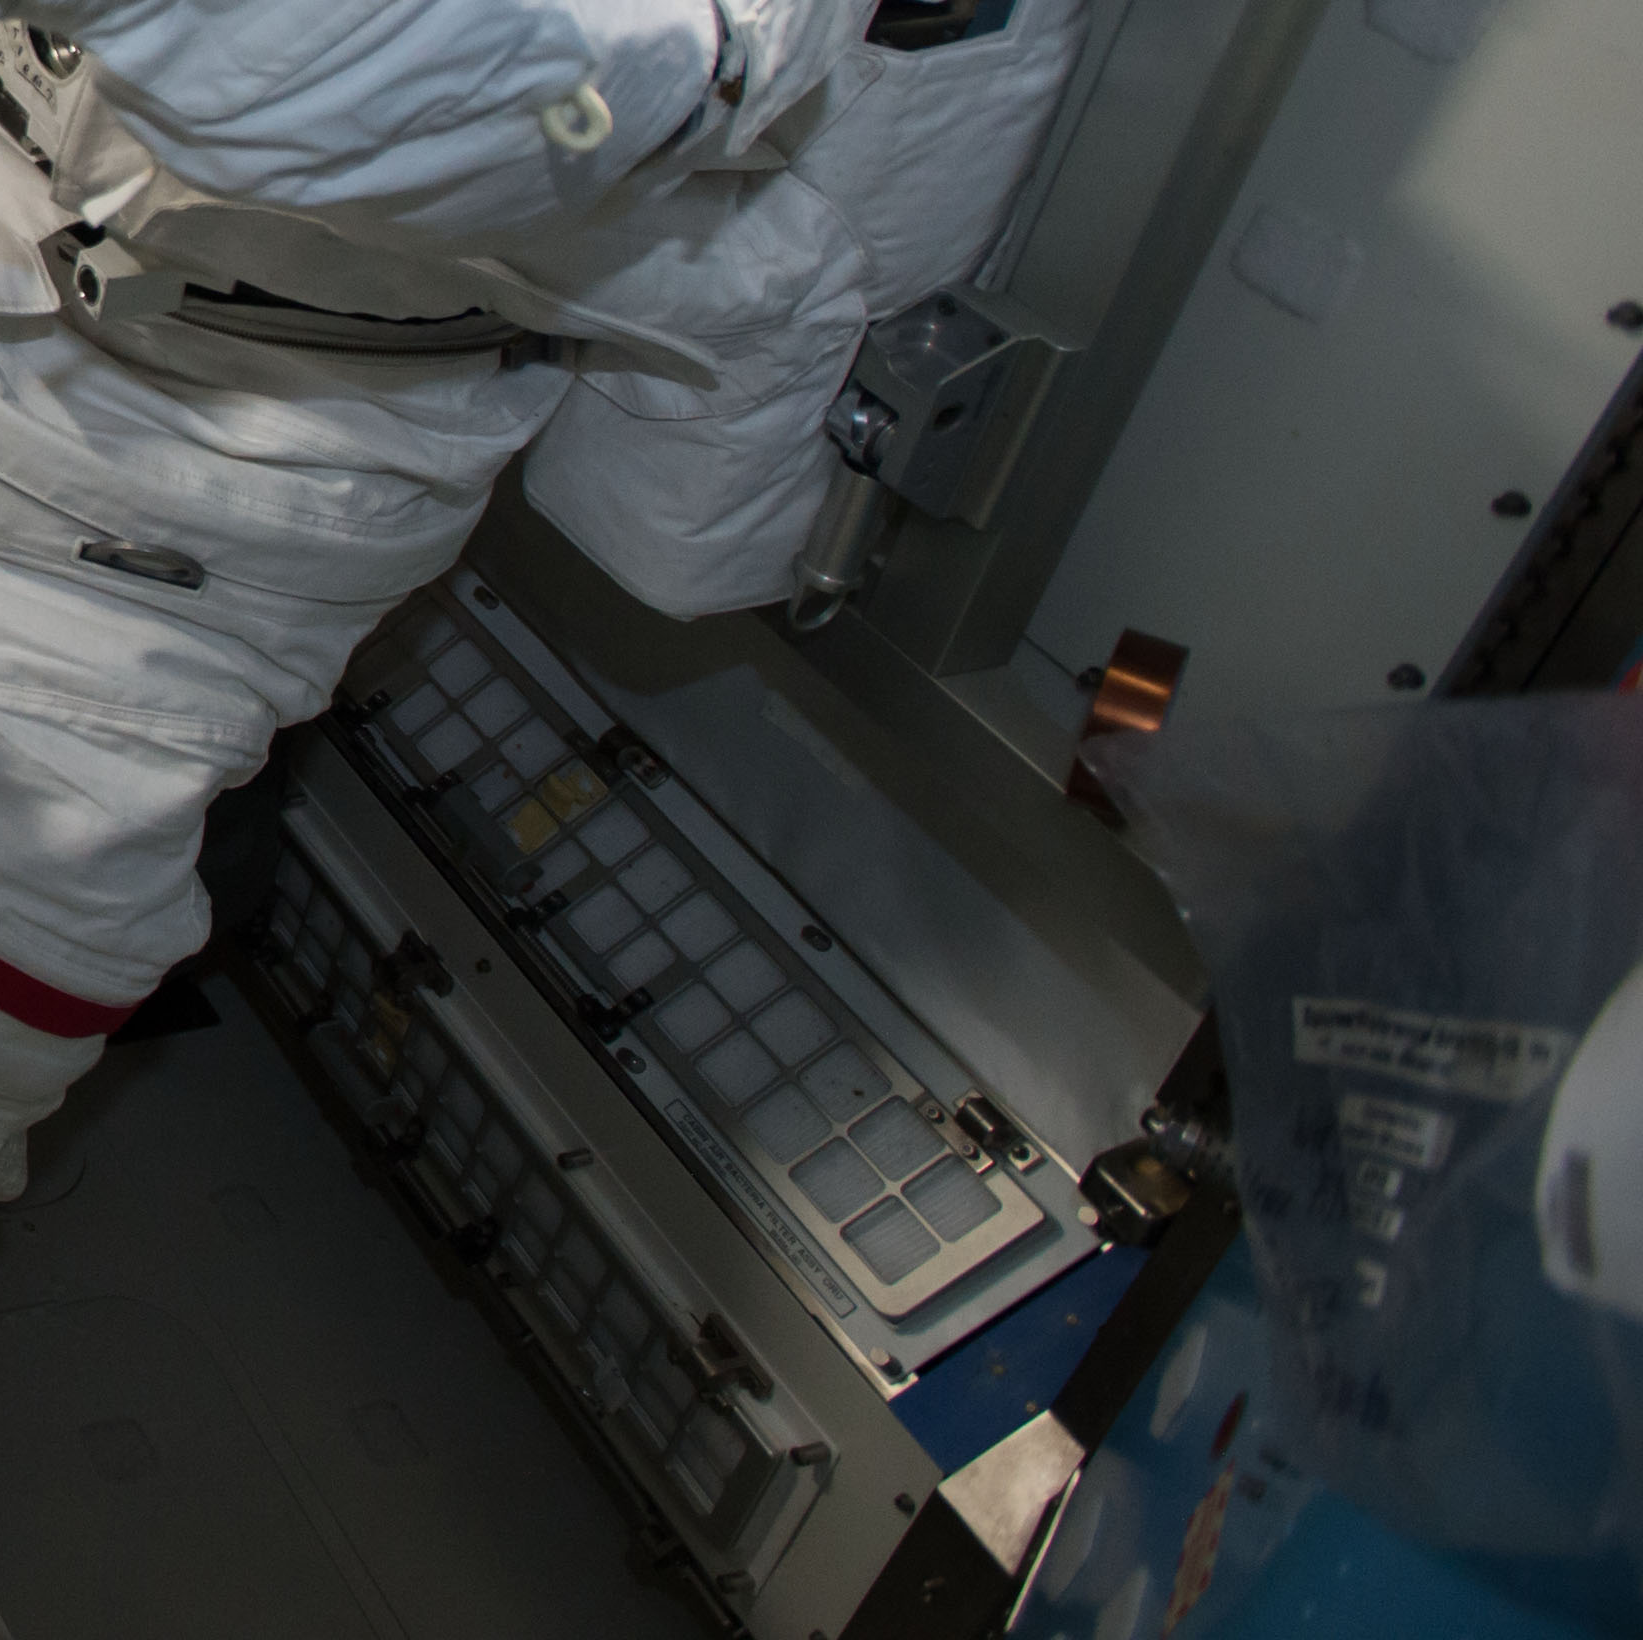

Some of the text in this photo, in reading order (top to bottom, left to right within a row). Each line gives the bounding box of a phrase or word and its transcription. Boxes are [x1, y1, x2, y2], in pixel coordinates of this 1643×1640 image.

[682, 1113, 709, 1143] CABIN
[725, 1161, 765, 1210] BACTERIA
[766, 1211, 798, 1246] FILTER
[797, 1248, 823, 1275] ASSY
